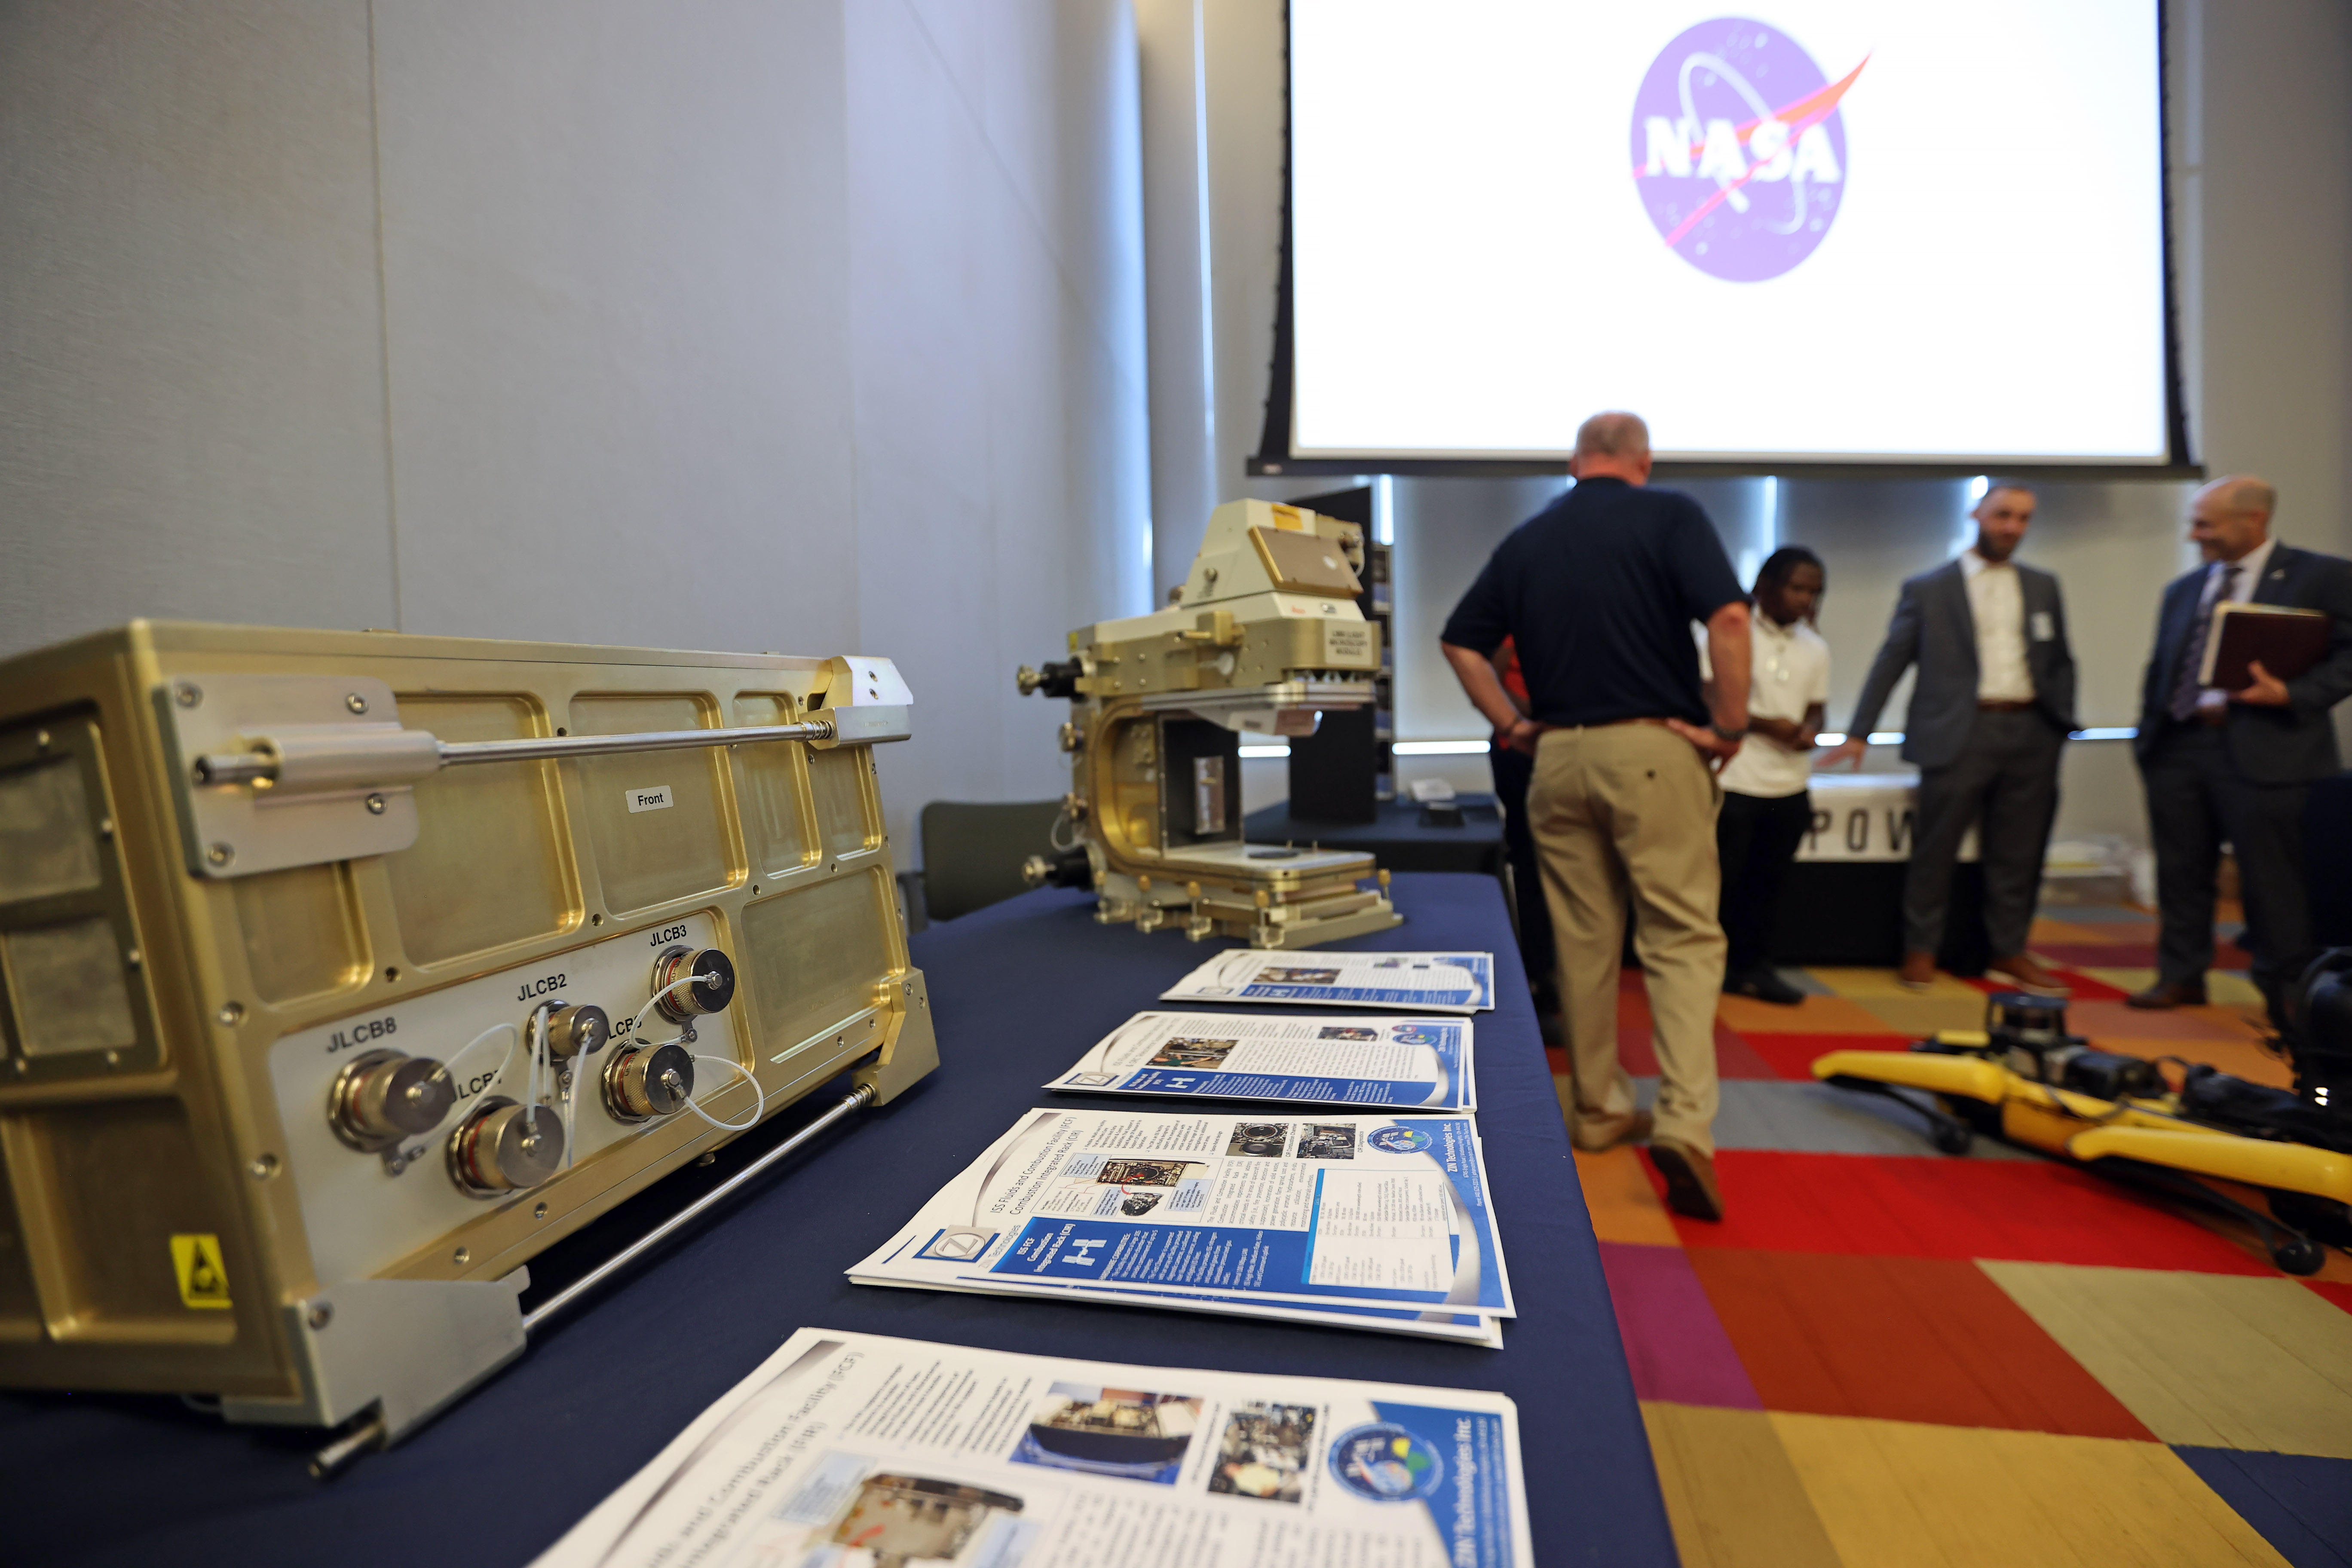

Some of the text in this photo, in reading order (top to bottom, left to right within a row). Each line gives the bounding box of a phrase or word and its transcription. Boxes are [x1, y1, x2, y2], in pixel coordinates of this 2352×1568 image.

[1645, 116, 1841, 183] NASA
[638, 793, 664, 806] Front
[650, 925, 687, 946] JLCB3
[517, 974, 567, 1001] JLCB2
[326, 1017, 397, 1053] JLCB8
[1442, 1123, 1458, 1172] ZIN Technologies Inc.
[990, 1117, 1076, 1213] ISS Fluids and Combustion Facility (FCF)
[1010, 1130, 1083, 1215] Combustion Integrated Rack (CIR)
[988, 1225, 1023, 1258] Technologies
[1017, 1237, 1035, 1255] ISS FCF
[1027, 1233, 1053, 1261] Combustion
[1034, 1223, 1075, 1272] Integrated Rack (CIR)
